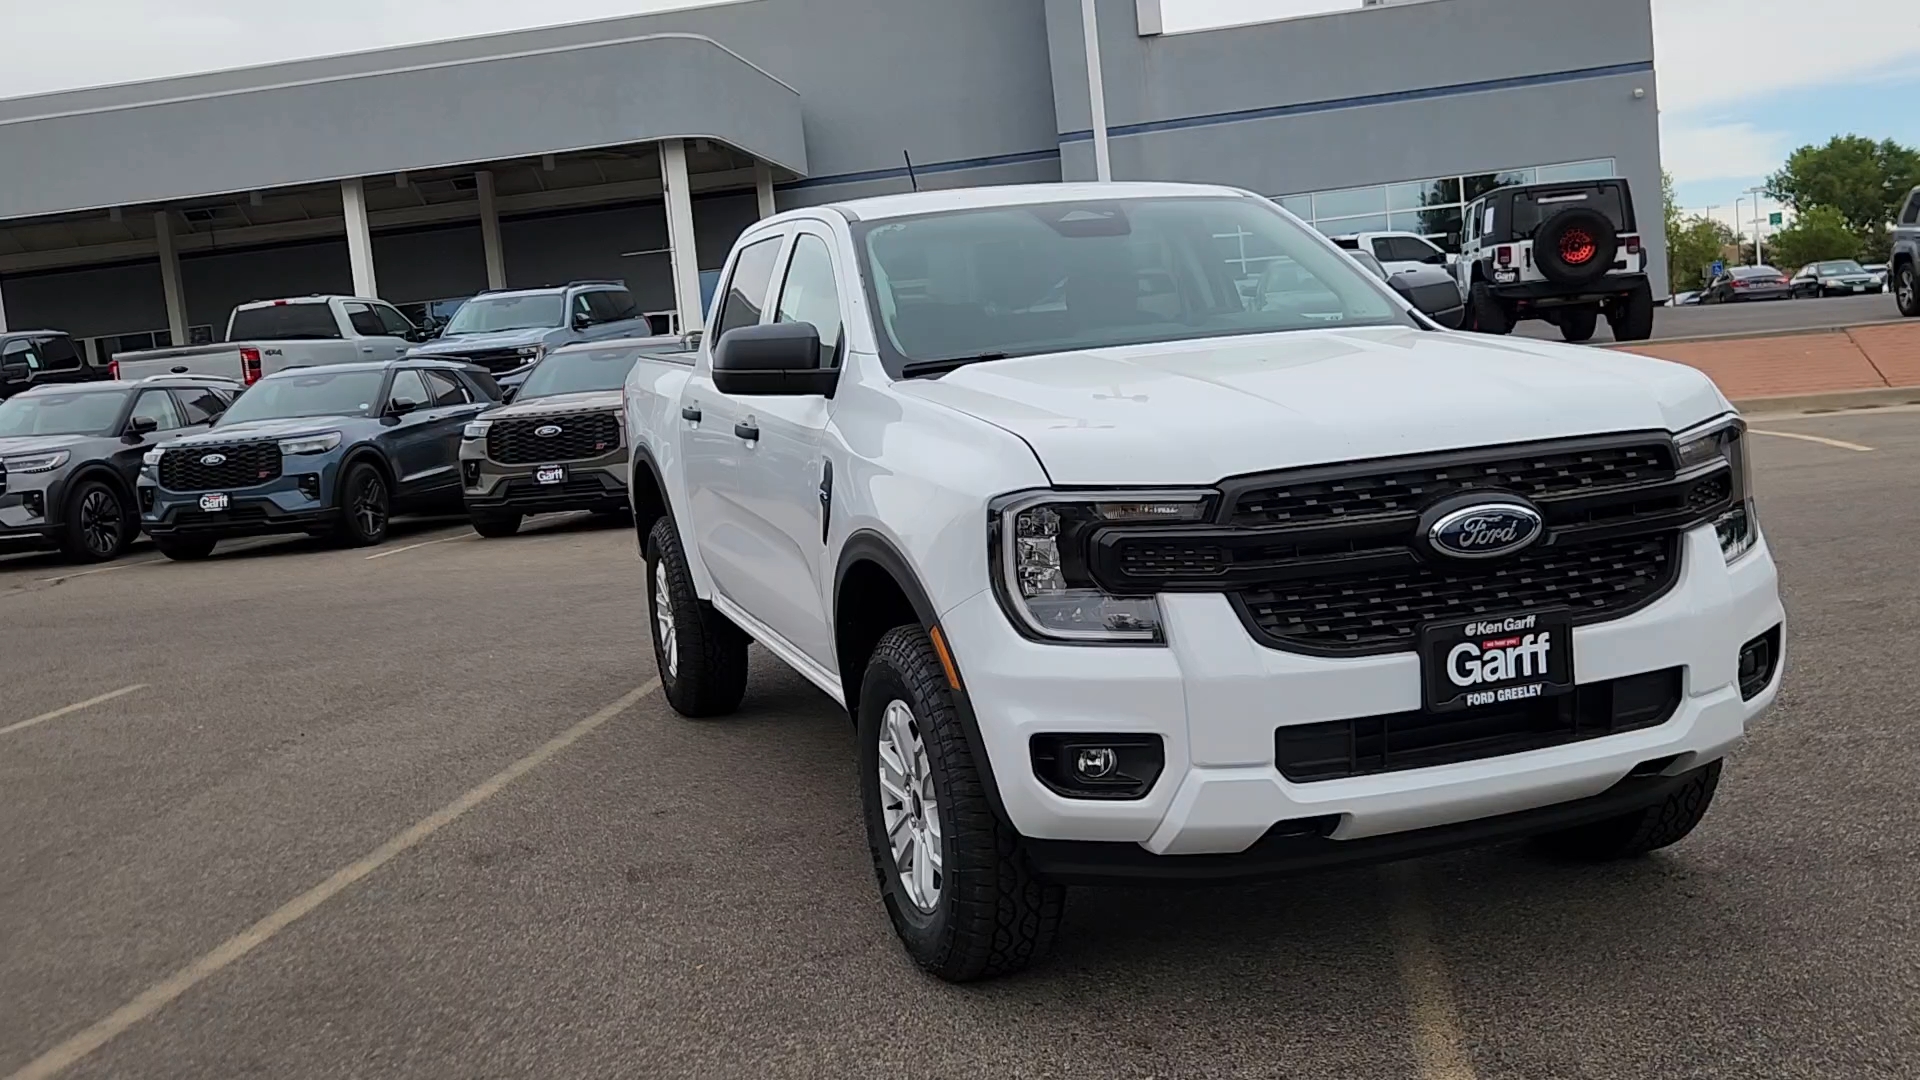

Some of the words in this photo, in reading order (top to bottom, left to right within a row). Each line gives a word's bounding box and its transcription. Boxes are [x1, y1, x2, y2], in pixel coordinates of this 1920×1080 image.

[536, 468, 563, 481] Garff
[199, 495, 228, 510] Garff
[1459, 515, 1518, 548] Ford
[1476, 621, 1503, 636] Ken
[1503, 614, 1536, 632] Garff
[1446, 631, 1550, 687] Garff
[1466, 690, 1496, 707] FORD
[1496, 683, 1543, 702] GREELEY
